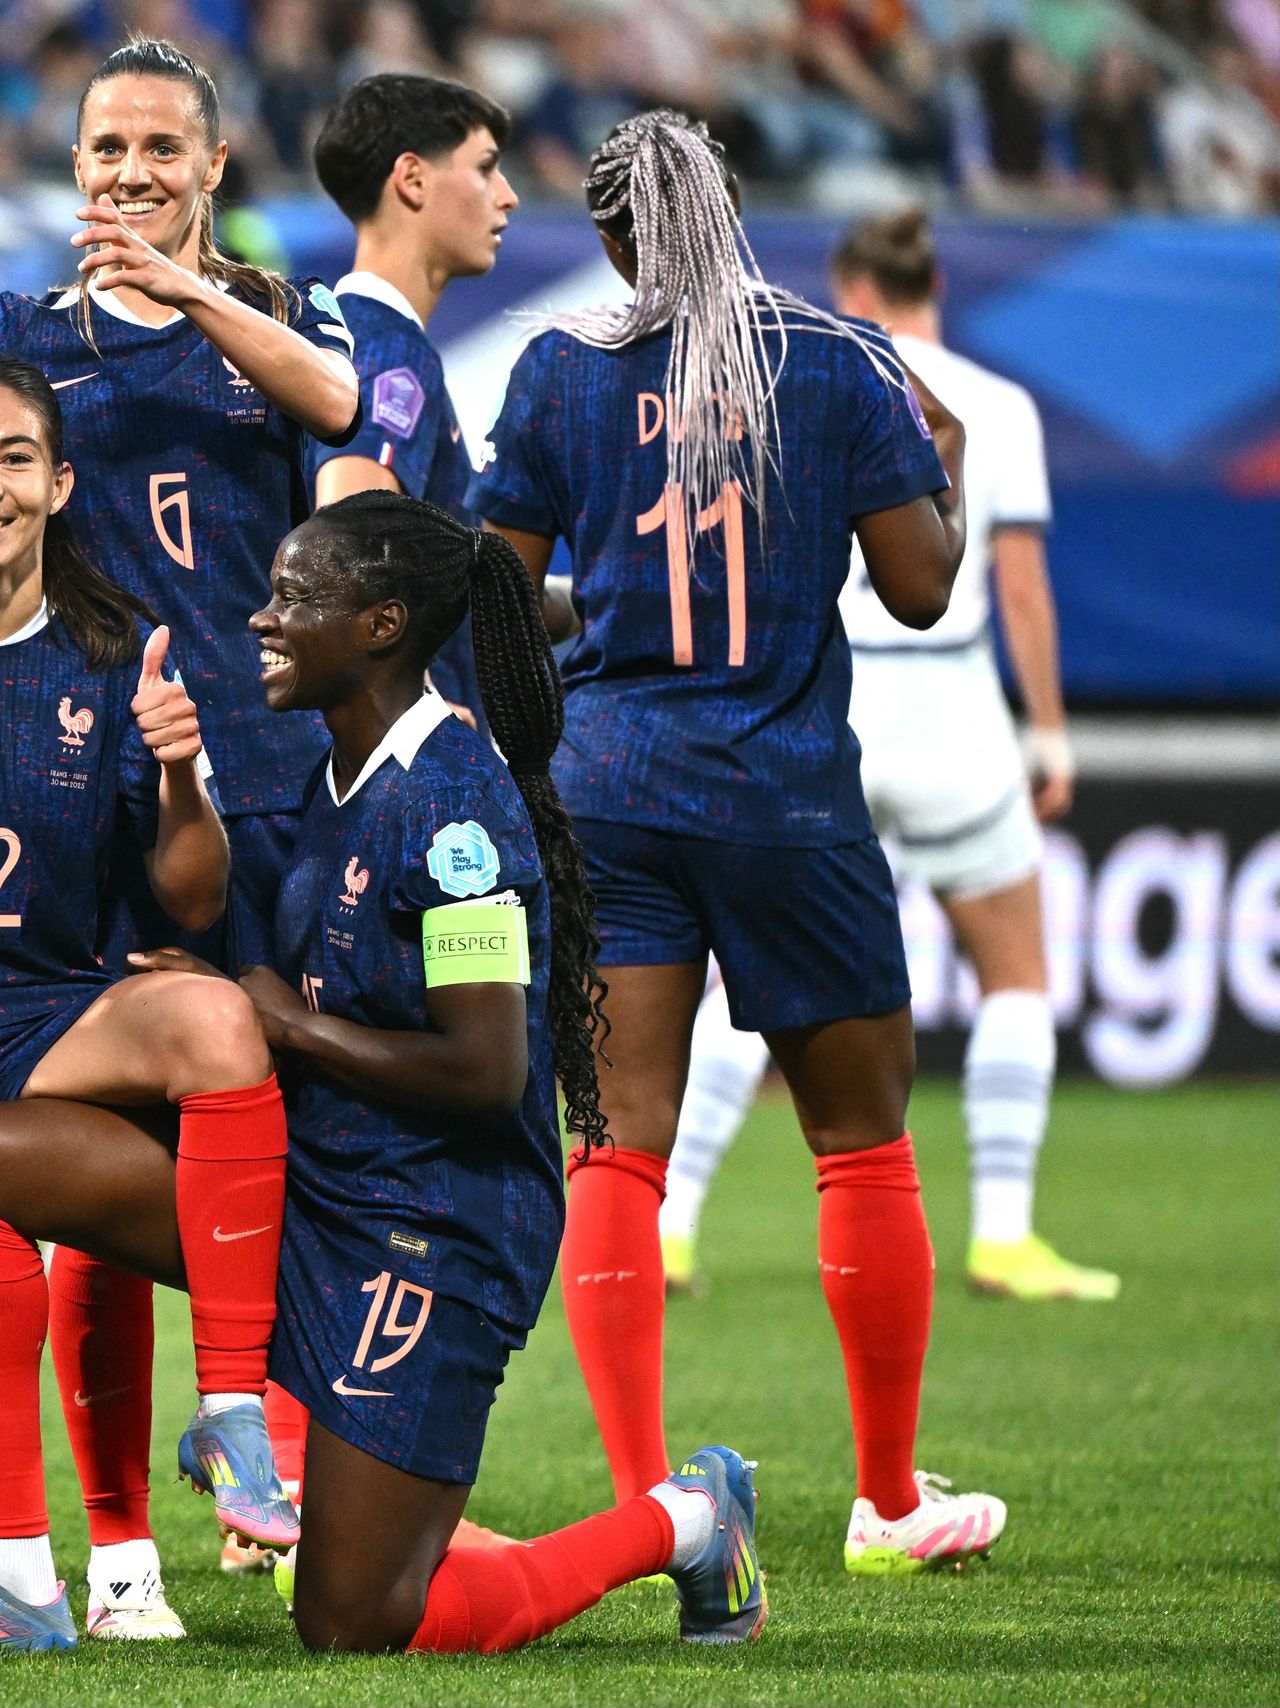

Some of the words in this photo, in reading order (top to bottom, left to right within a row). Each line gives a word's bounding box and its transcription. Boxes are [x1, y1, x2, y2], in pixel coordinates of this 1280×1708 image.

[149, 472, 195, 571] 6
[636, 480, 746, 666] 11
[50, 770, 67, 778] FRANCE
[70, 781, 85, 789] 2025
[450, 847, 464, 855] We
[451, 855, 471, 865] Play
[452, 863, 483, 872] Strong
[438, 936, 508, 953] RESPECT
[352, 1271, 433, 1373] 19
